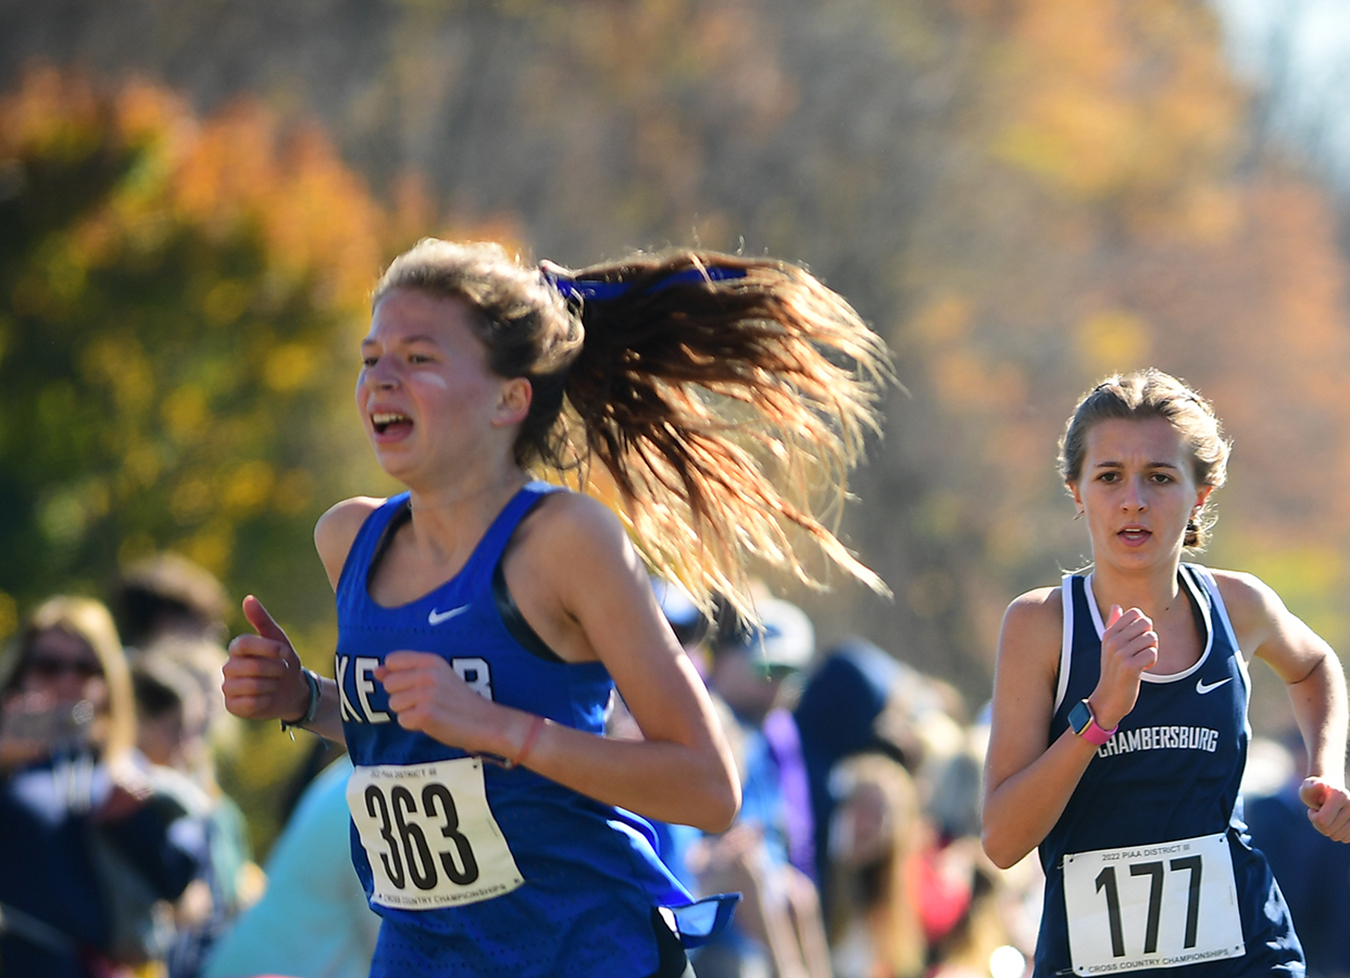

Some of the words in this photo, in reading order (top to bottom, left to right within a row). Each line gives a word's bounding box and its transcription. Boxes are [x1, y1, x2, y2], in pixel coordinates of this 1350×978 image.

[364, 783, 479, 891] 363
[1102, 852, 1120, 861] 2022
[1122, 850, 1142, 859] PIAA
[1144, 844, 1181, 857] DISTRICT
[1094, 855, 1203, 958] 177
[1088, 963, 1118, 973] CROSS
[1120, 958, 1160, 970] COUNTRY
[1163, 948, 1229, 965] CHAMPIONSHIPS
